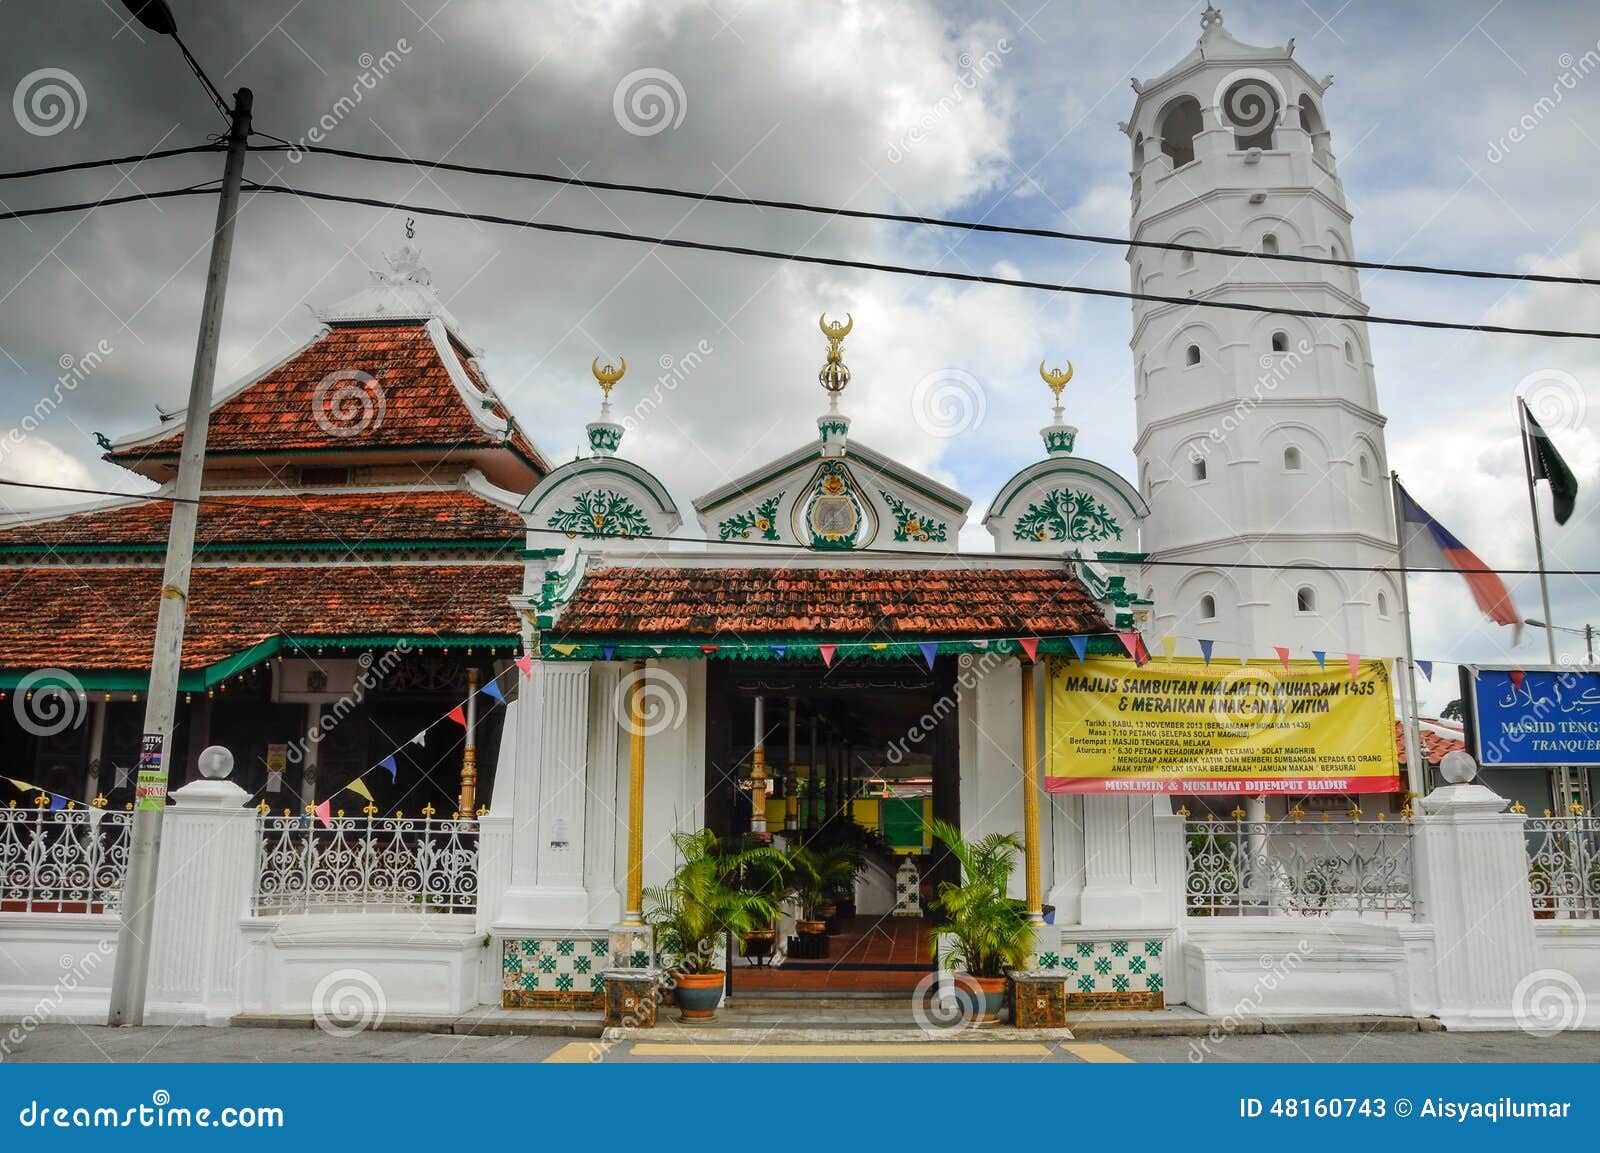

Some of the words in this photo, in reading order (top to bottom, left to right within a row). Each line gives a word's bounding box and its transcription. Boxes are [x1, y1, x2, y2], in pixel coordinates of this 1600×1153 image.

[1065, 676, 1119, 693] MAJLIS
[1122, 679, 1198, 695] SAMBUTAN
[1200, 681, 1251, 696] MALAM
[1255, 682, 1269, 695] 10
[1273, 682, 1341, 697] MUHARAM
[1344, 681, 1375, 696] 1435
[1118, 696, 1128, 712] &
[1131, 697, 1206, 713] MERAIKAN
[1209, 699, 1288, 714] ANAK-ANAK
[1290, 698, 1330, 714] YATIM
[1112, 720, 1133, 729] RABU,
[1145, 721, 1185, 729] NOVEMBER
[1186, 721, 1203, 729] 2013
[1501, 722, 1556, 734] MASJID
[1558, 722, 1600, 734] TENG
[1129, 730, 1157, 738] PETANG
[1158, 730, 1192, 738] (SELEPAS
[1069, 737, 1107, 746] Bertempat
[1261, 747, 1283, 755] SOLAT
[1117, 756, 1157, 764] MENGUSAP
[1202, 756, 1223, 764] YATIM
[1225, 756, 1241, 764] DAN
[1242, 756, 1272, 764] MEMBERI
[1320, 764, 1357, 772] BERSURAI
[1104, 780, 1164, 791] MUSLIMIN
[1167, 780, 1179, 791] &
[1182, 780, 1242, 791] MUSLIMAT
[1244, 780, 1304, 792] DIJEMPUT
[1307, 780, 1348, 790] HADIR
